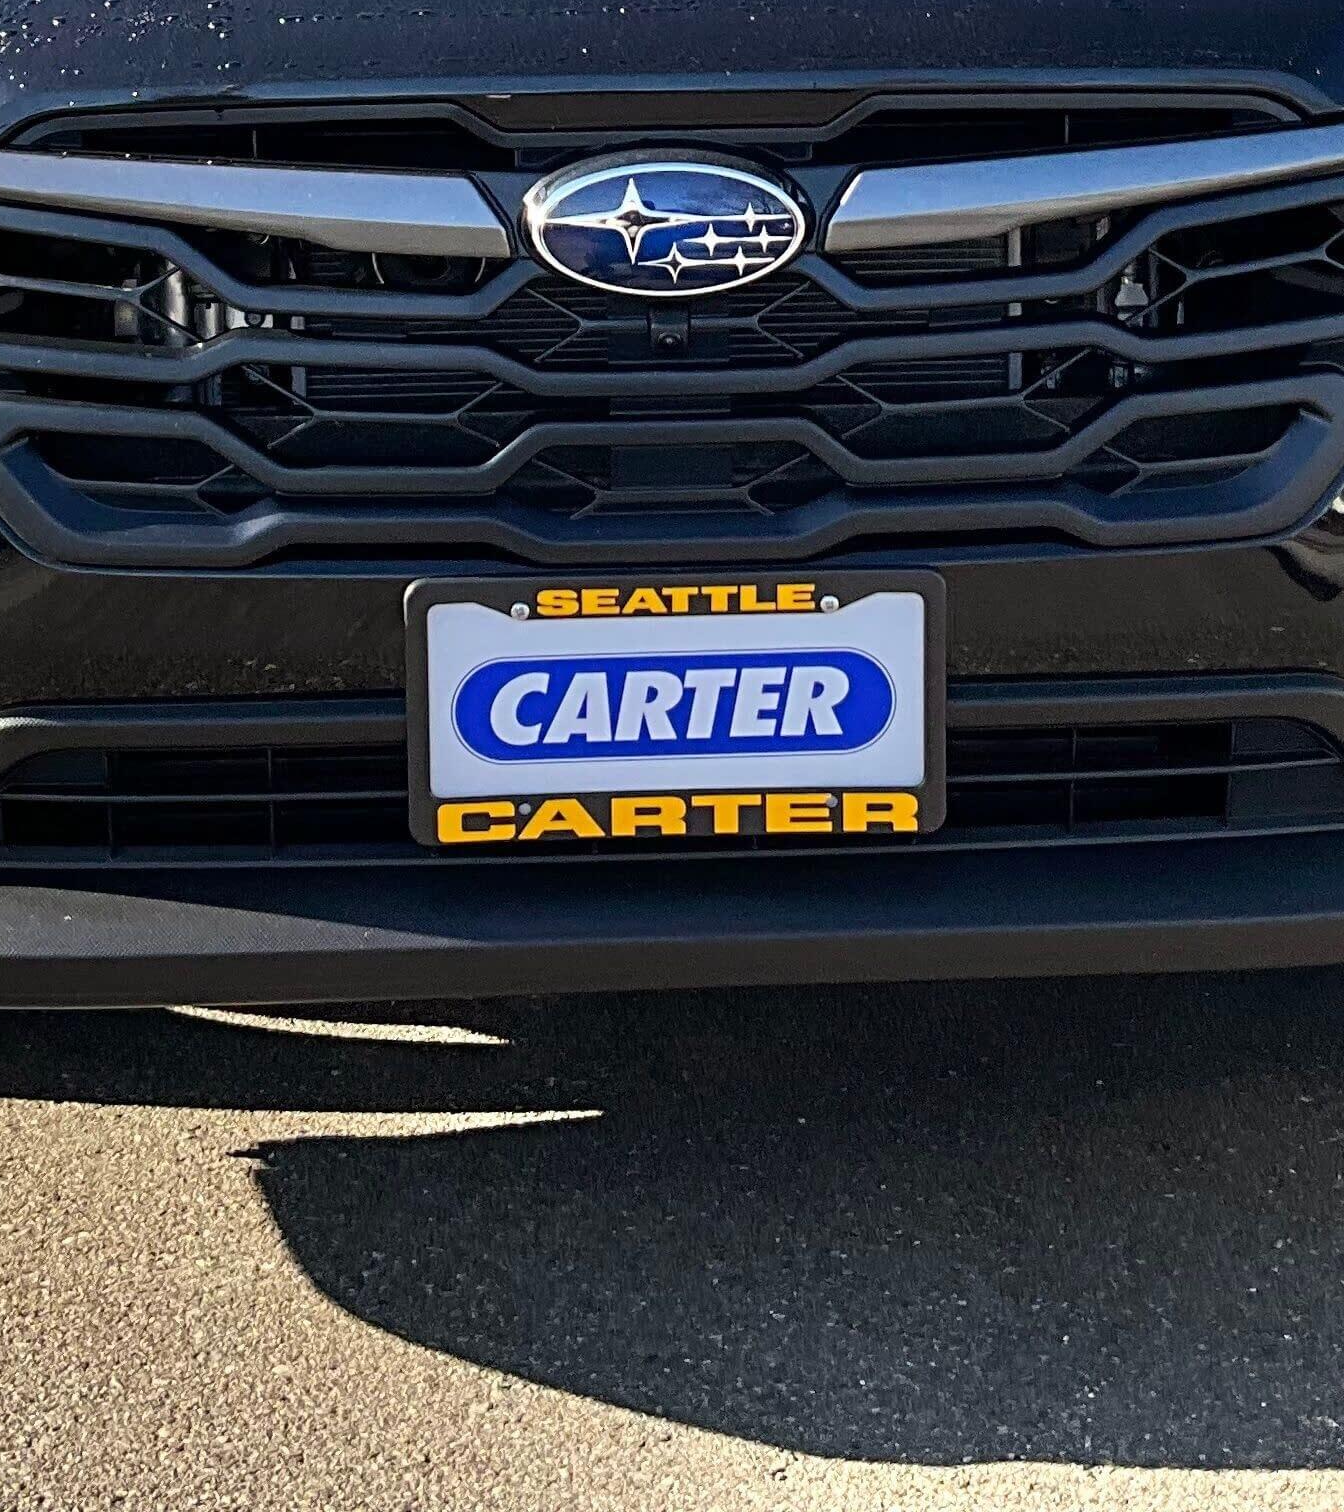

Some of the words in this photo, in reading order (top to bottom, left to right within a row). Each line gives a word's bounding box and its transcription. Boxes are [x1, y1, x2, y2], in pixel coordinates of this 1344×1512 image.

[536, 583, 816, 617] SEATTLE
[489, 665, 850, 746] CARTER
[436, 792, 919, 843] CARTER
